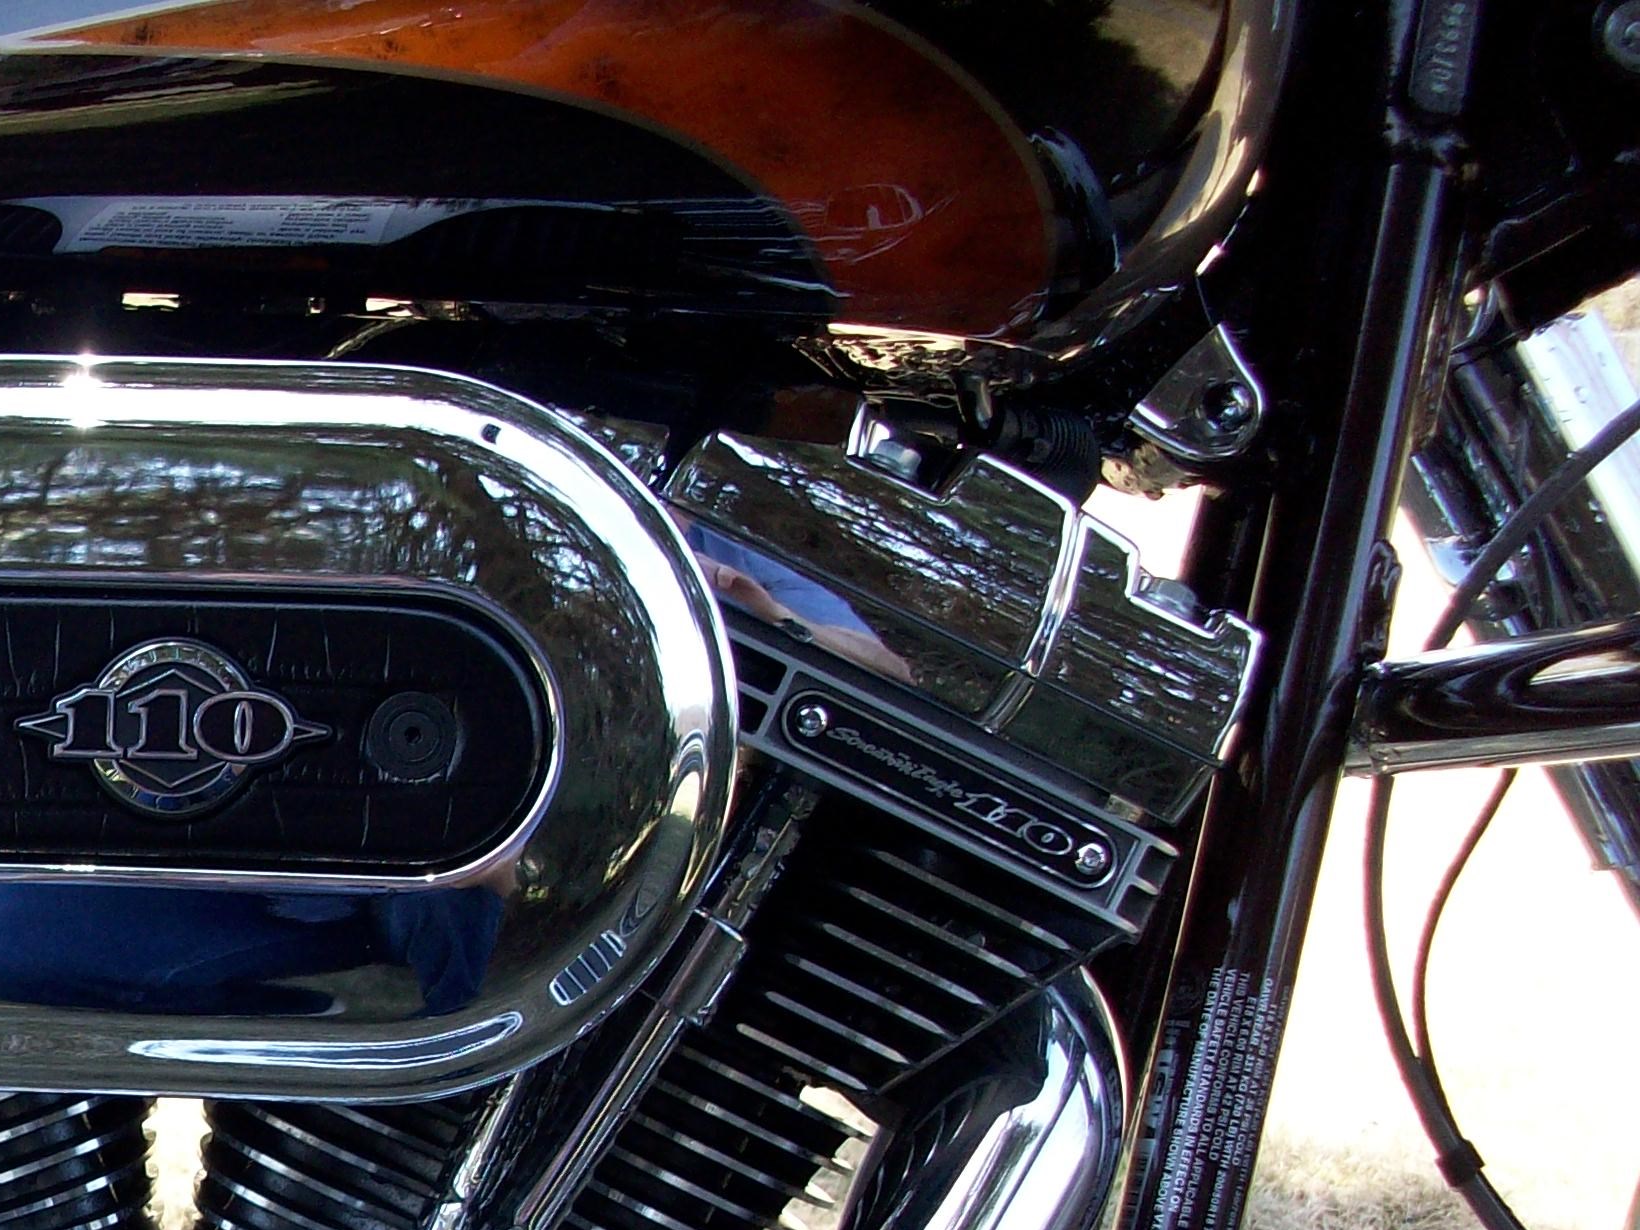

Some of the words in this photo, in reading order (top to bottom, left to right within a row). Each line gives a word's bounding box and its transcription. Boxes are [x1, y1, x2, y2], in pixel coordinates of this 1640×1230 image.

[54, 688, 295, 764] 110
[954, 792, 1073, 855] 110
[1210, 966, 1221, 987] THE
[1237, 972, 1249, 996] THIS
[1202, 991, 1216, 1020] DATE
[1219, 968, 1236, 1016] VEHICLE
[1199, 1023, 1209, 1036] OF
[1225, 999, 1243, 1047] VEHICLE
[1251, 1015, 1265, 1045] REAR
[1207, 1019, 1224, 1061] SAFETY
[1231, 1054, 1242, 1073] RIM
[1255, 1059, 1264, 1078] RIM
[1176, 1041, 1204, 1126] MANUFACTURE
[1208, 1050, 1230, 1113] CONFORMS
[1227, 1076, 1237, 1090] AT
[1240, 1076, 1250, 1091] KG
[1251, 1080, 1259, 1095] AT
[1189, 1065, 1213, 1133] STANDARDS
[1224, 1093, 1233, 1105] 42
[1203, 1118, 1213, 1131] TO
[1219, 1109, 1229, 1126] PSI
[1241, 1114, 1251, 1132] PSI
[1166, 1129, 1182, 1170] SHOWN
[1186, 1136, 1195, 1146] IN
[1197, 1135, 1209, 1155] ALL
[1210, 1129, 1224, 1160] COLD
[1221, 1140, 1235, 1168] WITH
[1233, 1134, 1246, 1165] COLD
[1175, 1151, 1192, 1192] EFFECT
[1155, 1174, 1172, 1211] ABOVE
[1169, 1195, 1180, 1212] ON
[1179, 1158, 1203, 1227] APPLICABLE
